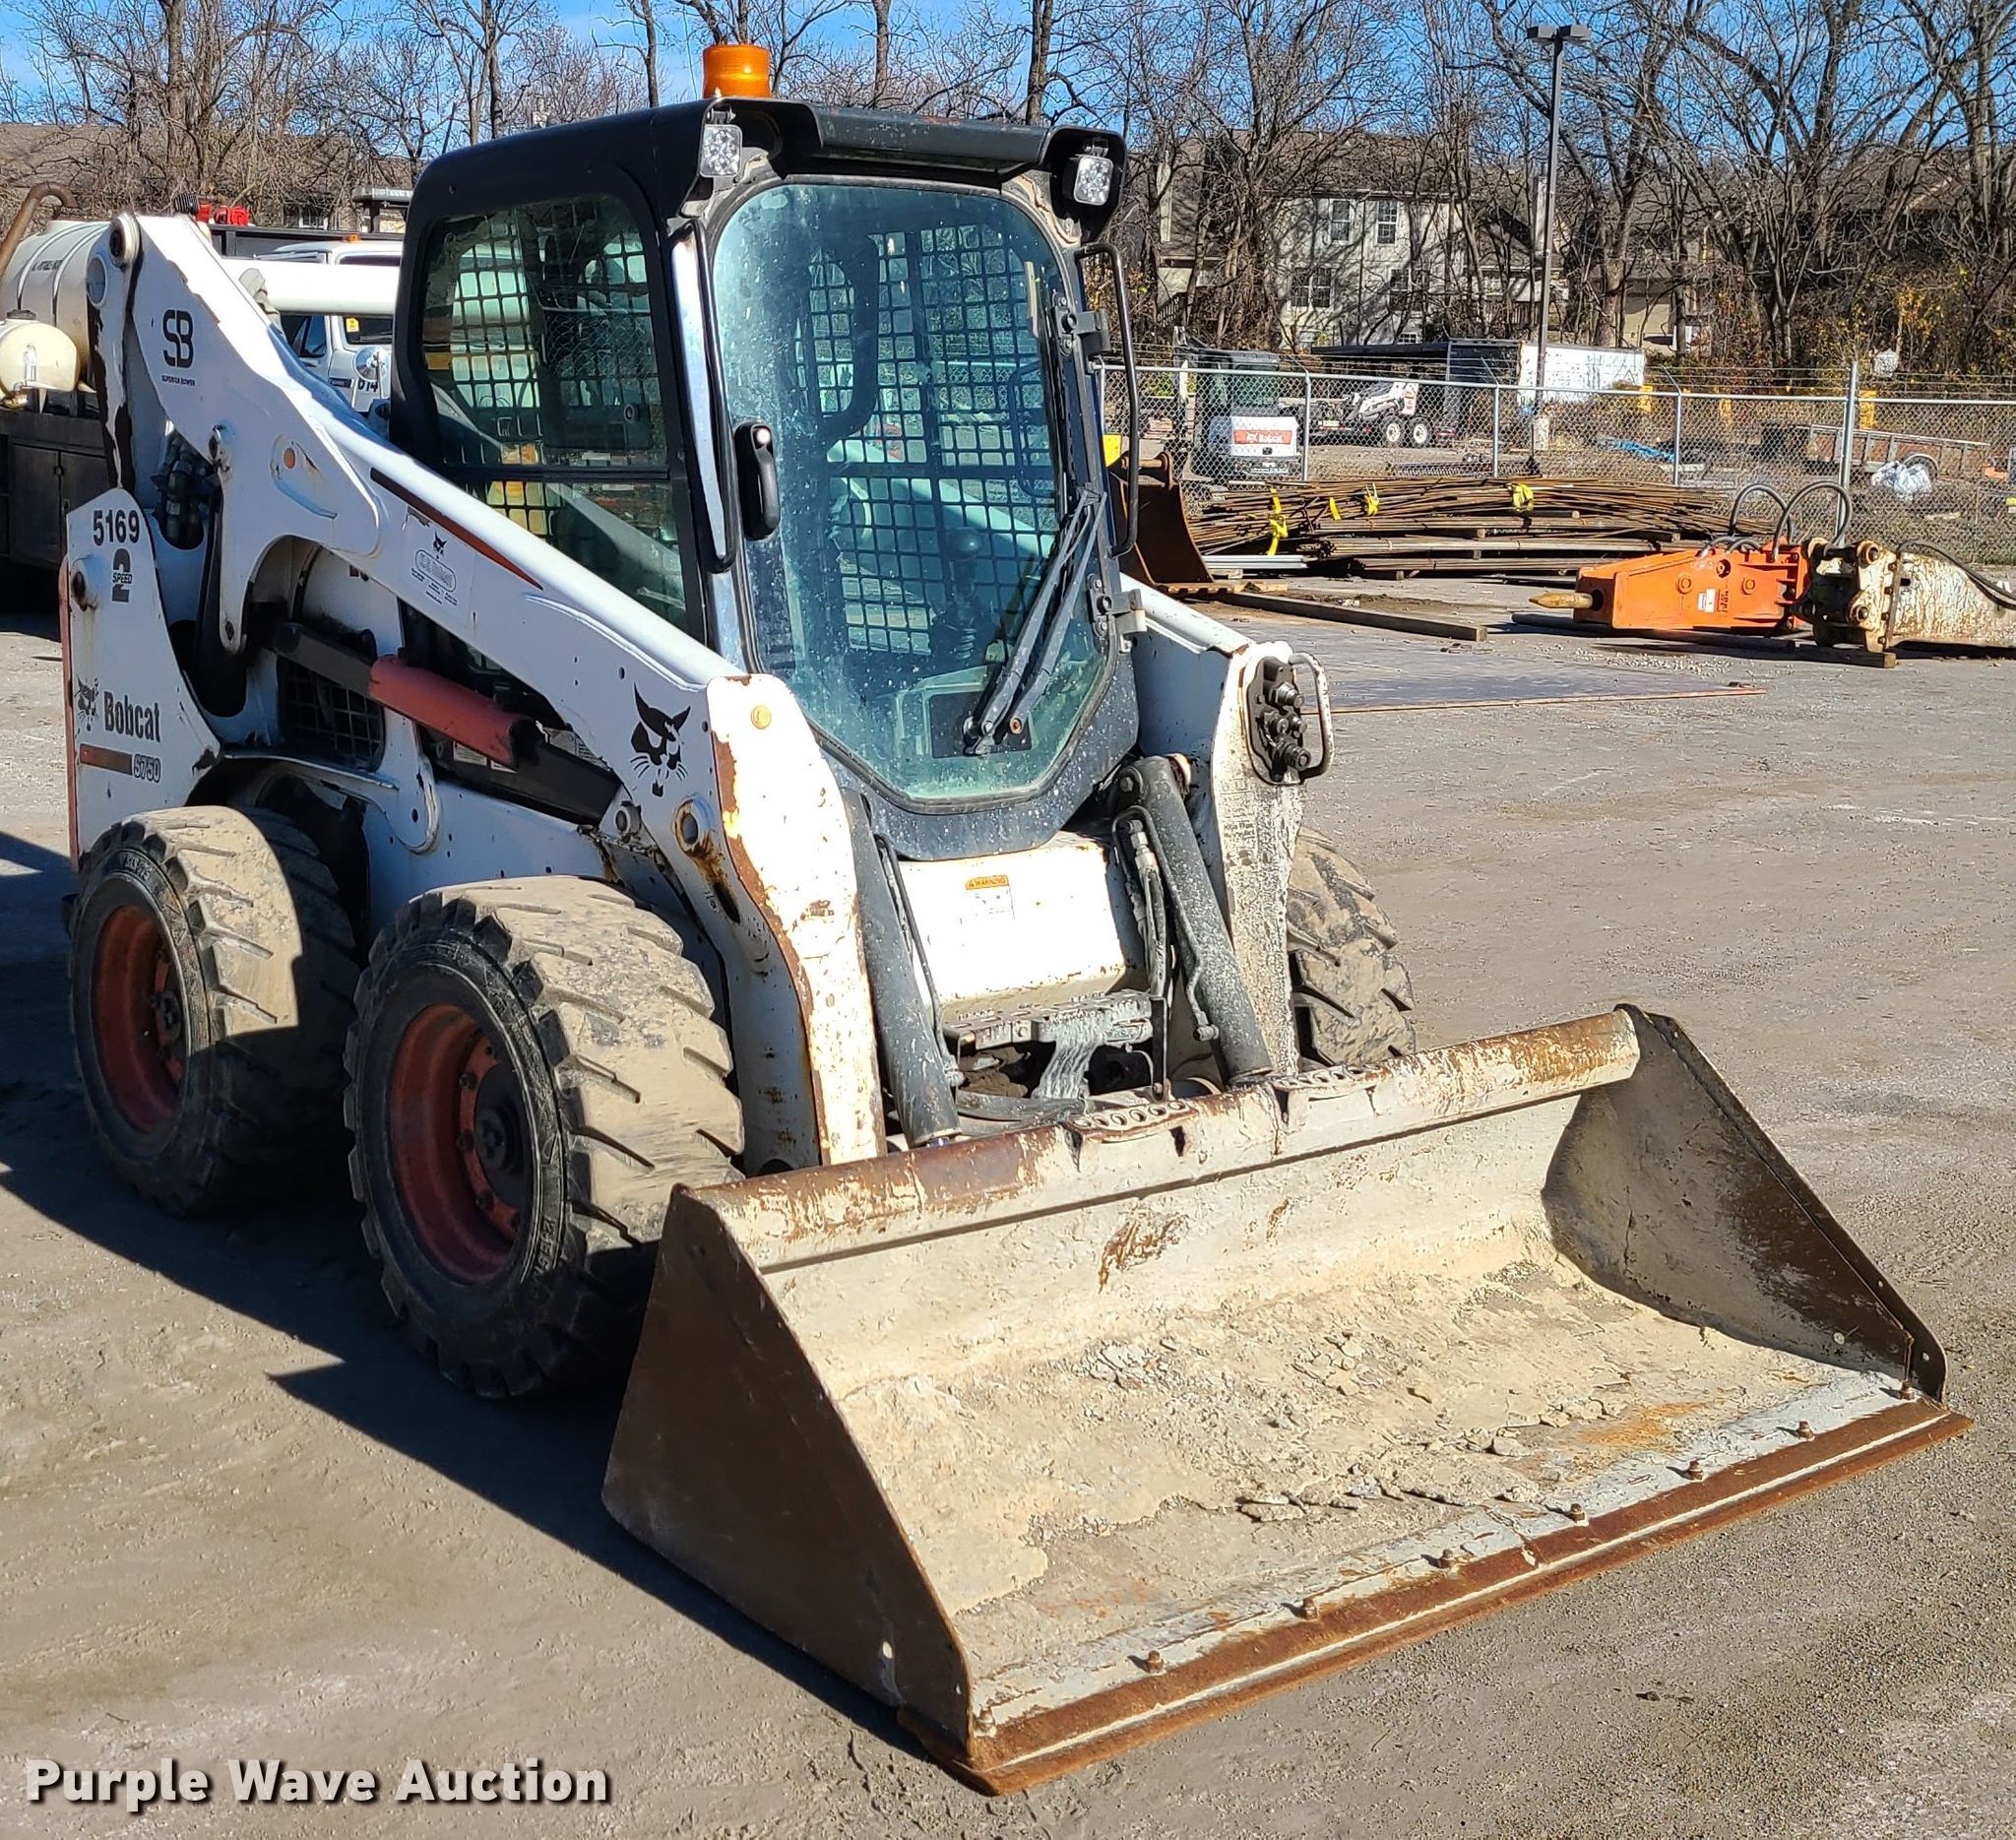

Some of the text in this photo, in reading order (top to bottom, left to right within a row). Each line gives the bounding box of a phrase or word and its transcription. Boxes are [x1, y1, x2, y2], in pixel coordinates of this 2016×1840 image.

[162, 308, 194, 369] SB
[93, 508, 140, 546] 5169
[111, 547, 131, 603] 2
[111, 571, 133, 585] SPEED
[103, 690, 161, 743] Bobcat
